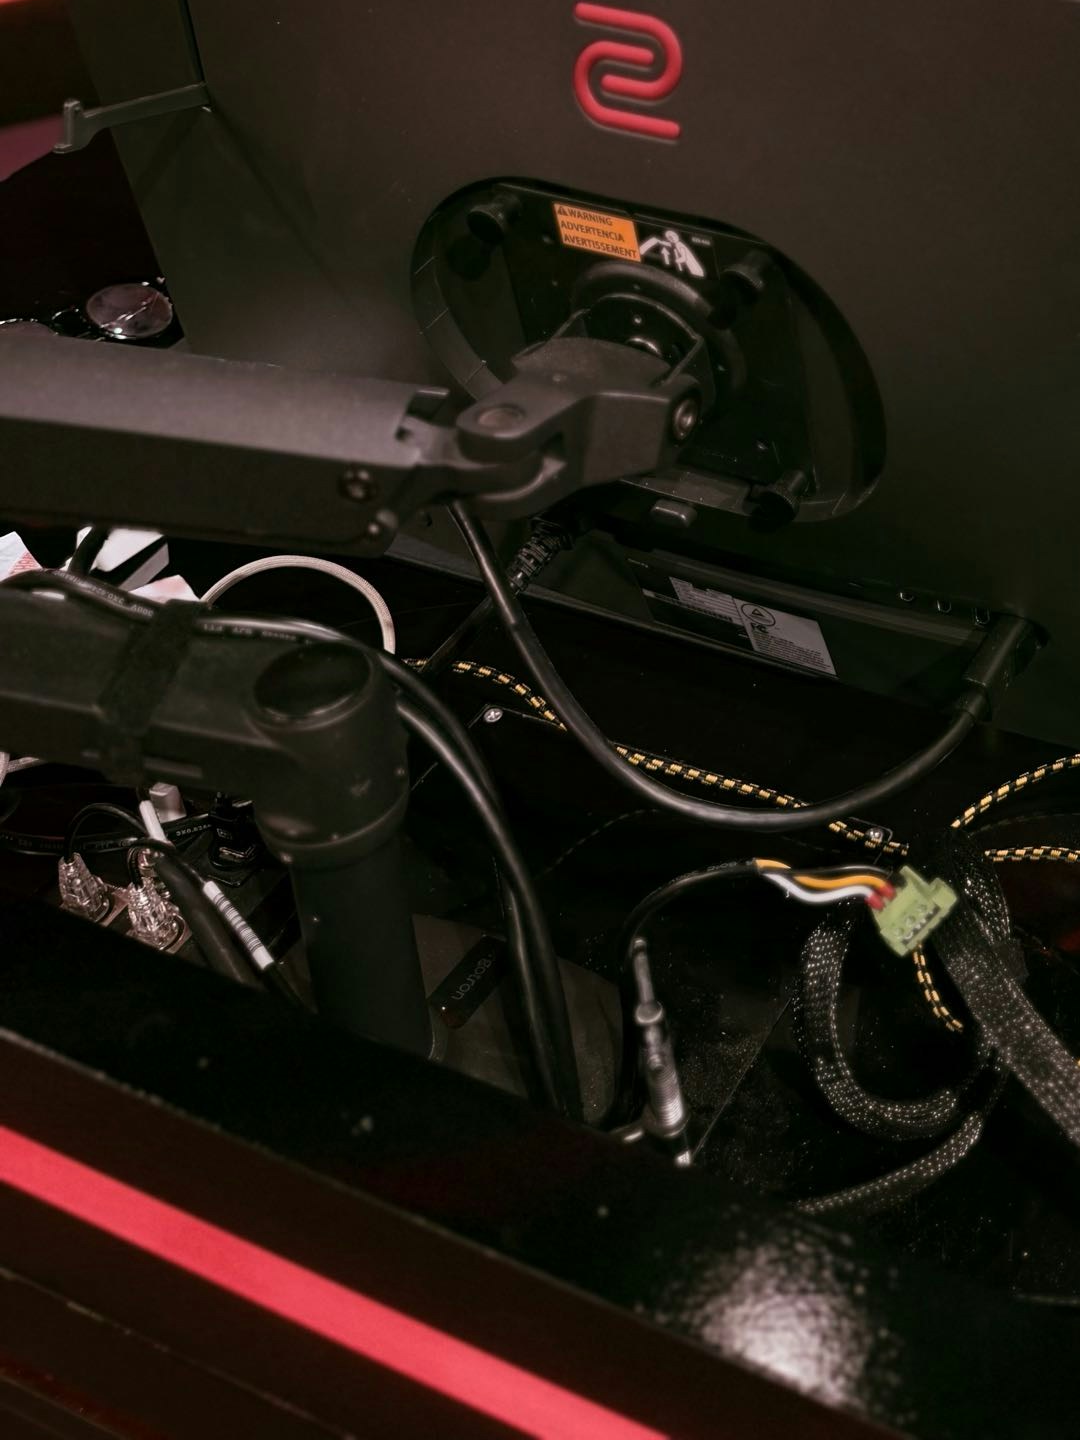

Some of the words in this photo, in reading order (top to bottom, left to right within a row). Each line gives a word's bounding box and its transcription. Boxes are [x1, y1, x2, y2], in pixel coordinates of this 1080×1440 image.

[568, 208, 613, 226] WARNING
[560, 220, 625, 242] ADVERTENCIA
[564, 234, 637, 258] AVERTISSEMENT
